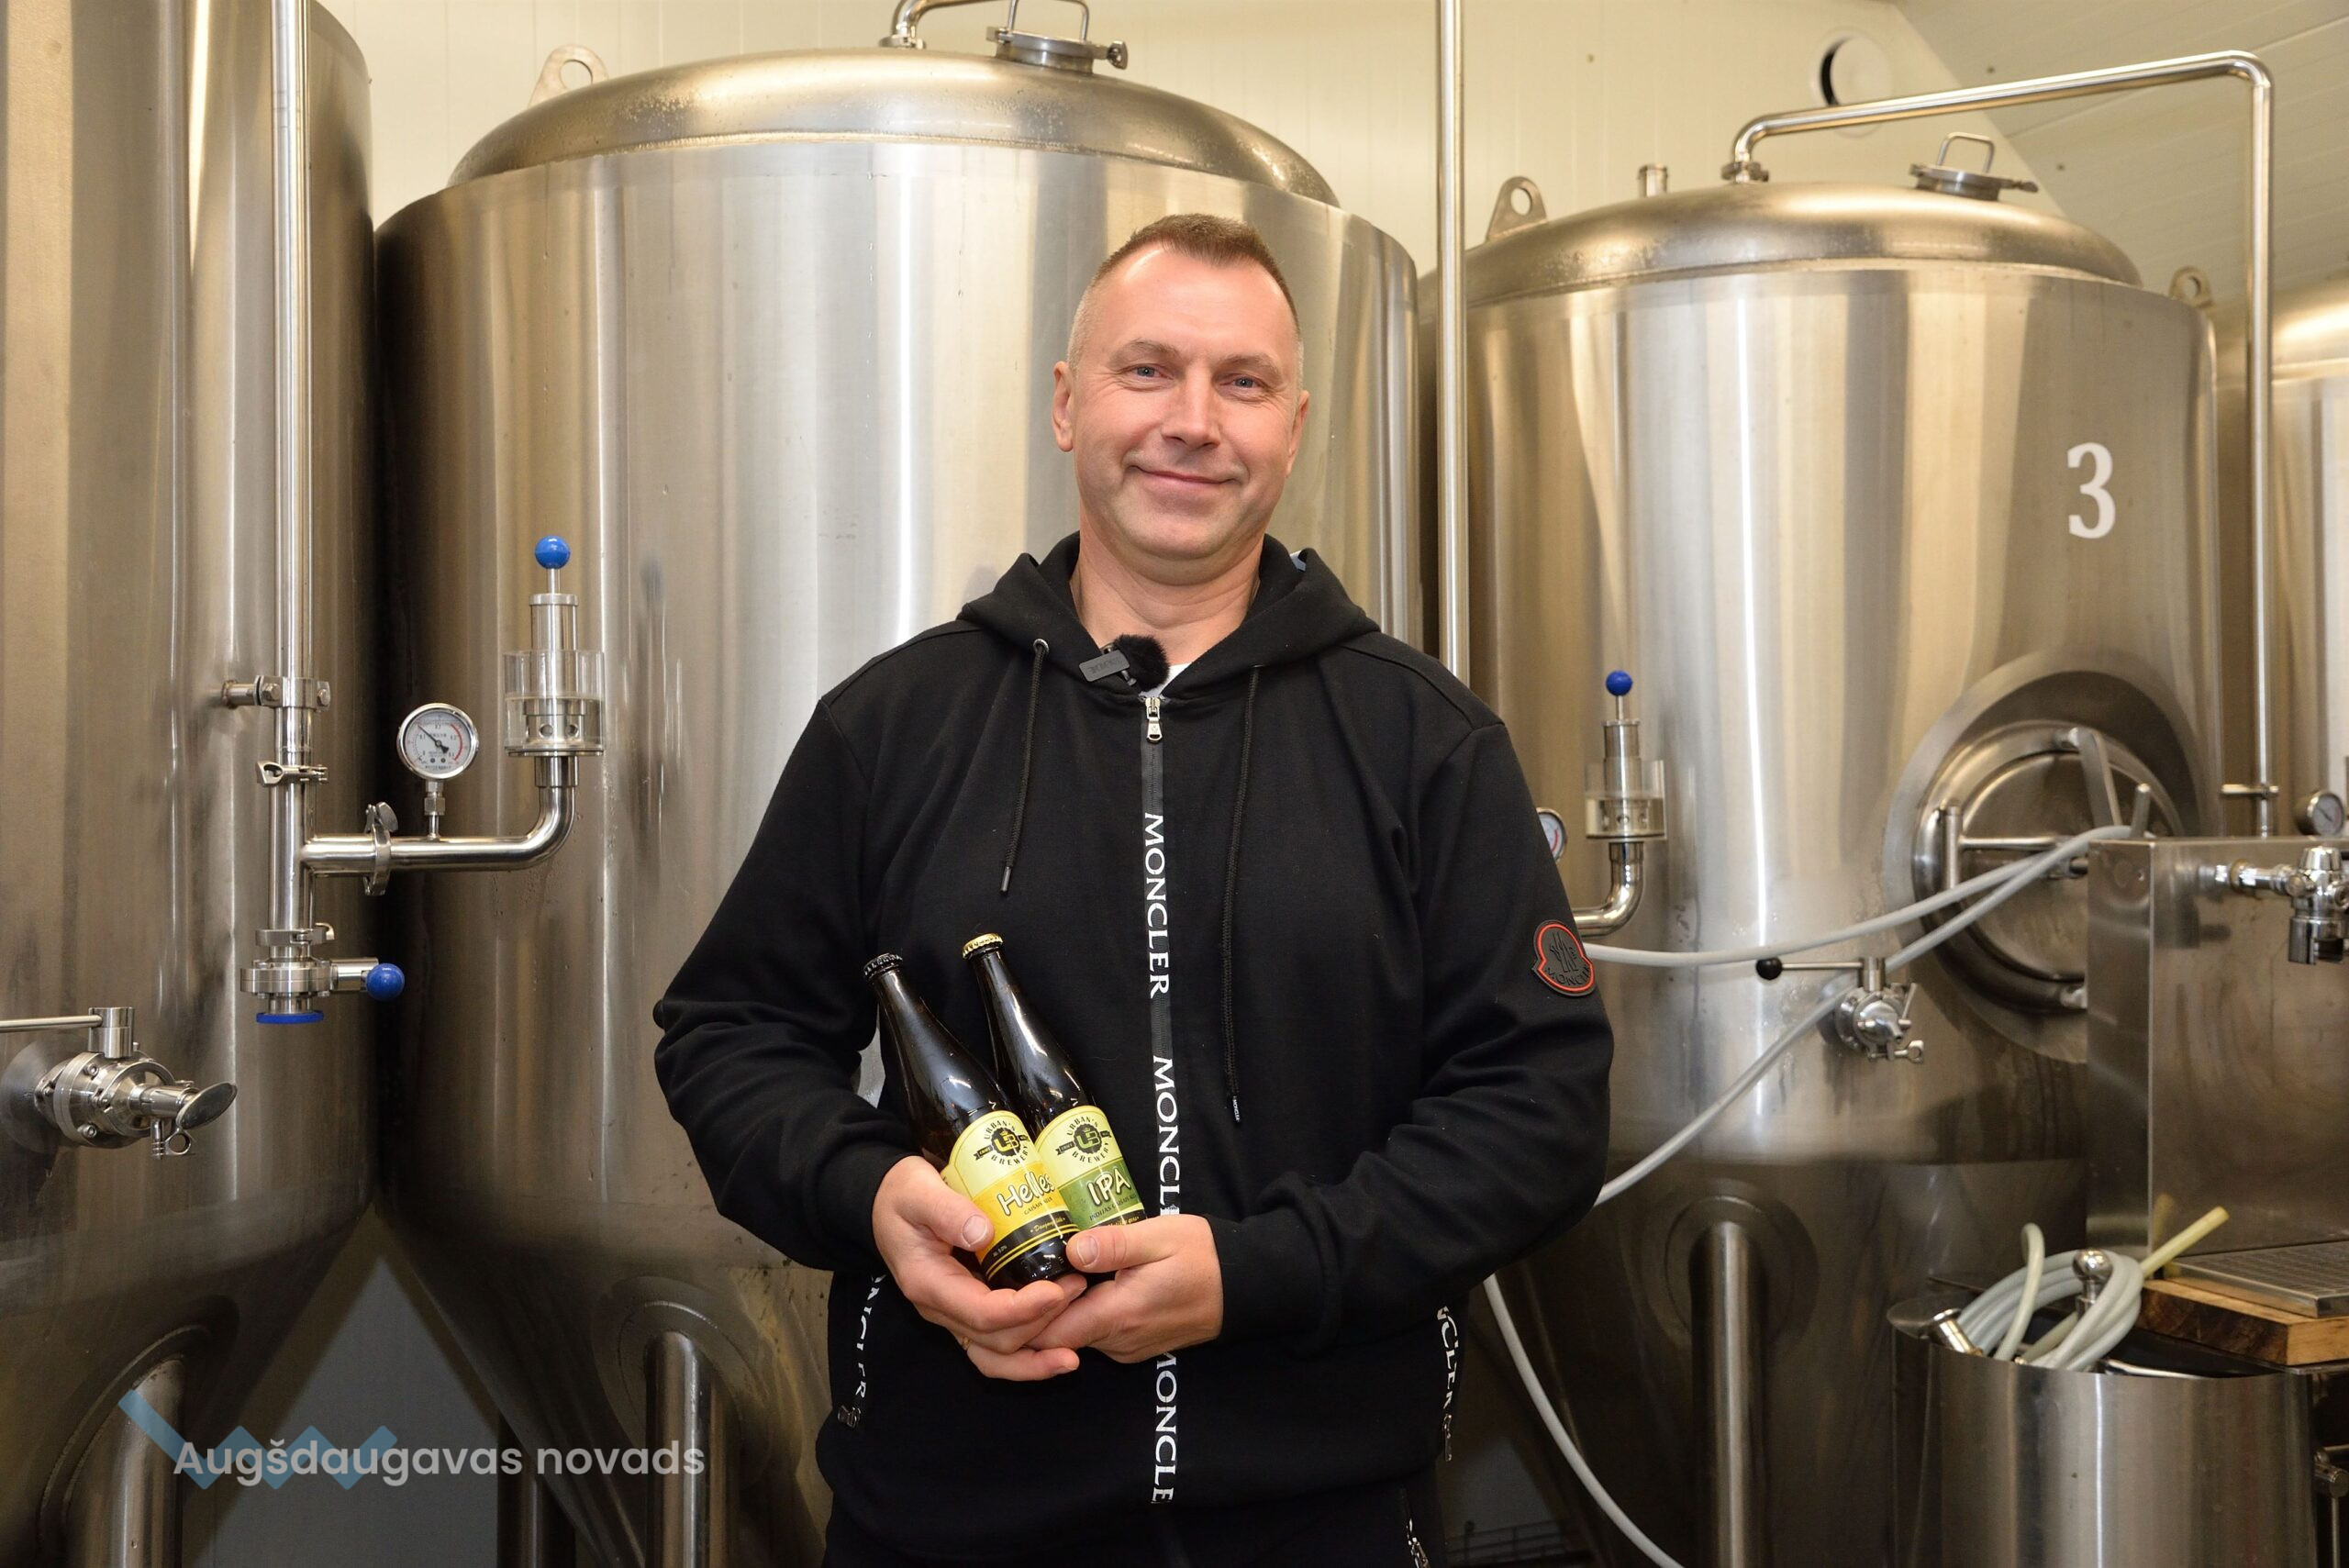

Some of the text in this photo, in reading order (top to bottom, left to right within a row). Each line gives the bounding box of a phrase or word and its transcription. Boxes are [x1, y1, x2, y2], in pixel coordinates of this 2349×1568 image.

[2067, 442, 2115, 539] 3
[1145, 812, 1170, 999] MONCLER
[991, 1146, 1029, 1166] BREWERY
[1072, 1142, 1109, 1163] BREWERY
[996, 1171, 1056, 1216] Helles
[1087, 1167, 1131, 1207] IPA
